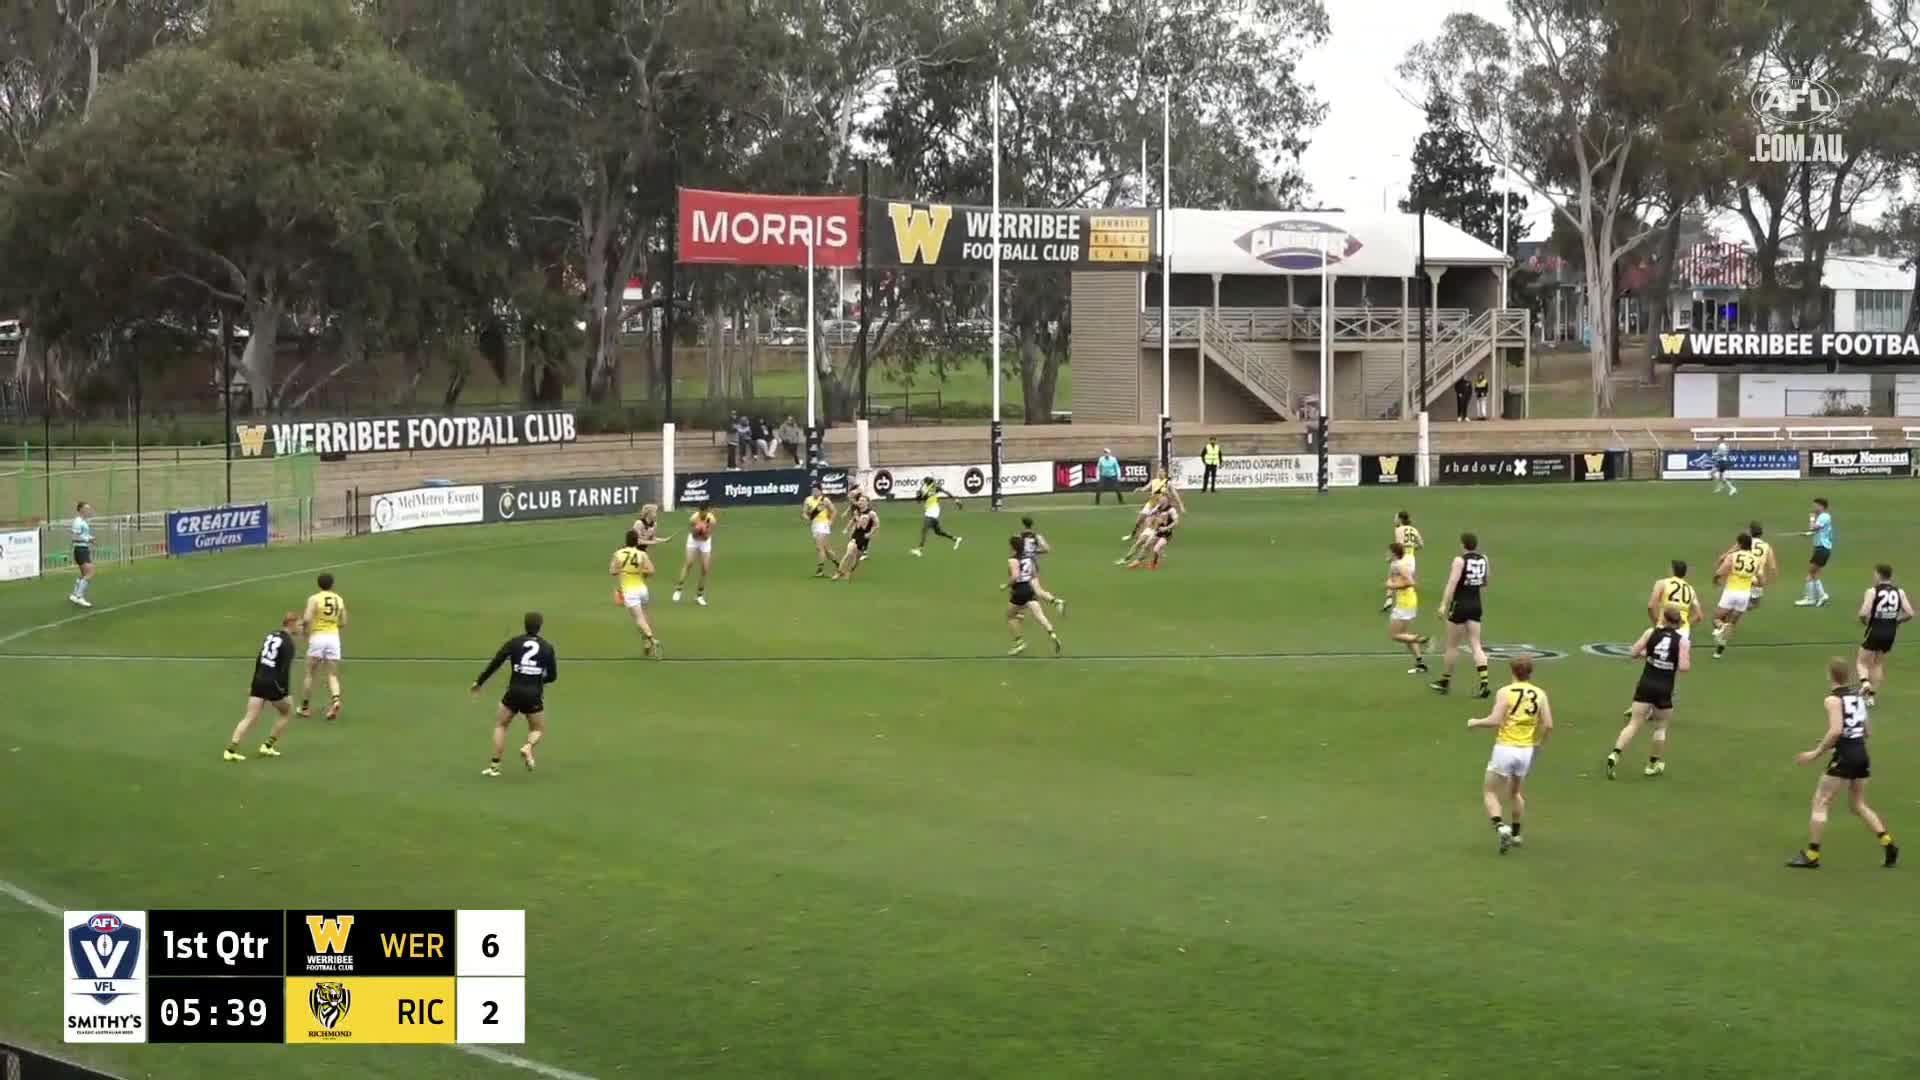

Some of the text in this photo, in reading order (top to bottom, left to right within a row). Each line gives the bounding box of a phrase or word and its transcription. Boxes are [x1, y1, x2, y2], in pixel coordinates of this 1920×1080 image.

[692, 209, 848, 247] MORRIS
[888, 203, 952, 264] W
[966, 211, 1080, 239] WERRIBEE
[1043, 244, 1080, 261] CLUB
[1690, 333, 1813, 355] WERRIBEE
[1822, 333, 1920, 355] FOOTBA
[272, 419, 400, 455] WERRIBEE
[408, 415, 518, 449] FOOTBALL
[525, 413, 576, 443] CLUB
[1728, 454, 1798, 463] WYNDHAM
[1813, 451, 1909, 465] Harvey Norman
[1125, 465, 1149, 476] STEEL
[517, 486, 639, 510] CLUB TARNEIT
[725, 483, 799, 498] Flying made easy
[176, 509, 262, 533] CREATIVE
[195, 532, 243, 549] Gardens
[622, 551, 639, 569] 74
[1466, 558, 1486, 579] 50
[1734, 553, 1755, 573] 53
[1668, 580, 1692, 604] 20
[1877, 589, 1899, 612] 29
[323, 596, 338, 617] 51
[520, 640, 540, 666] 2
[1653, 636, 1672, 661] 4
[1510, 688, 1538, 716] 73
